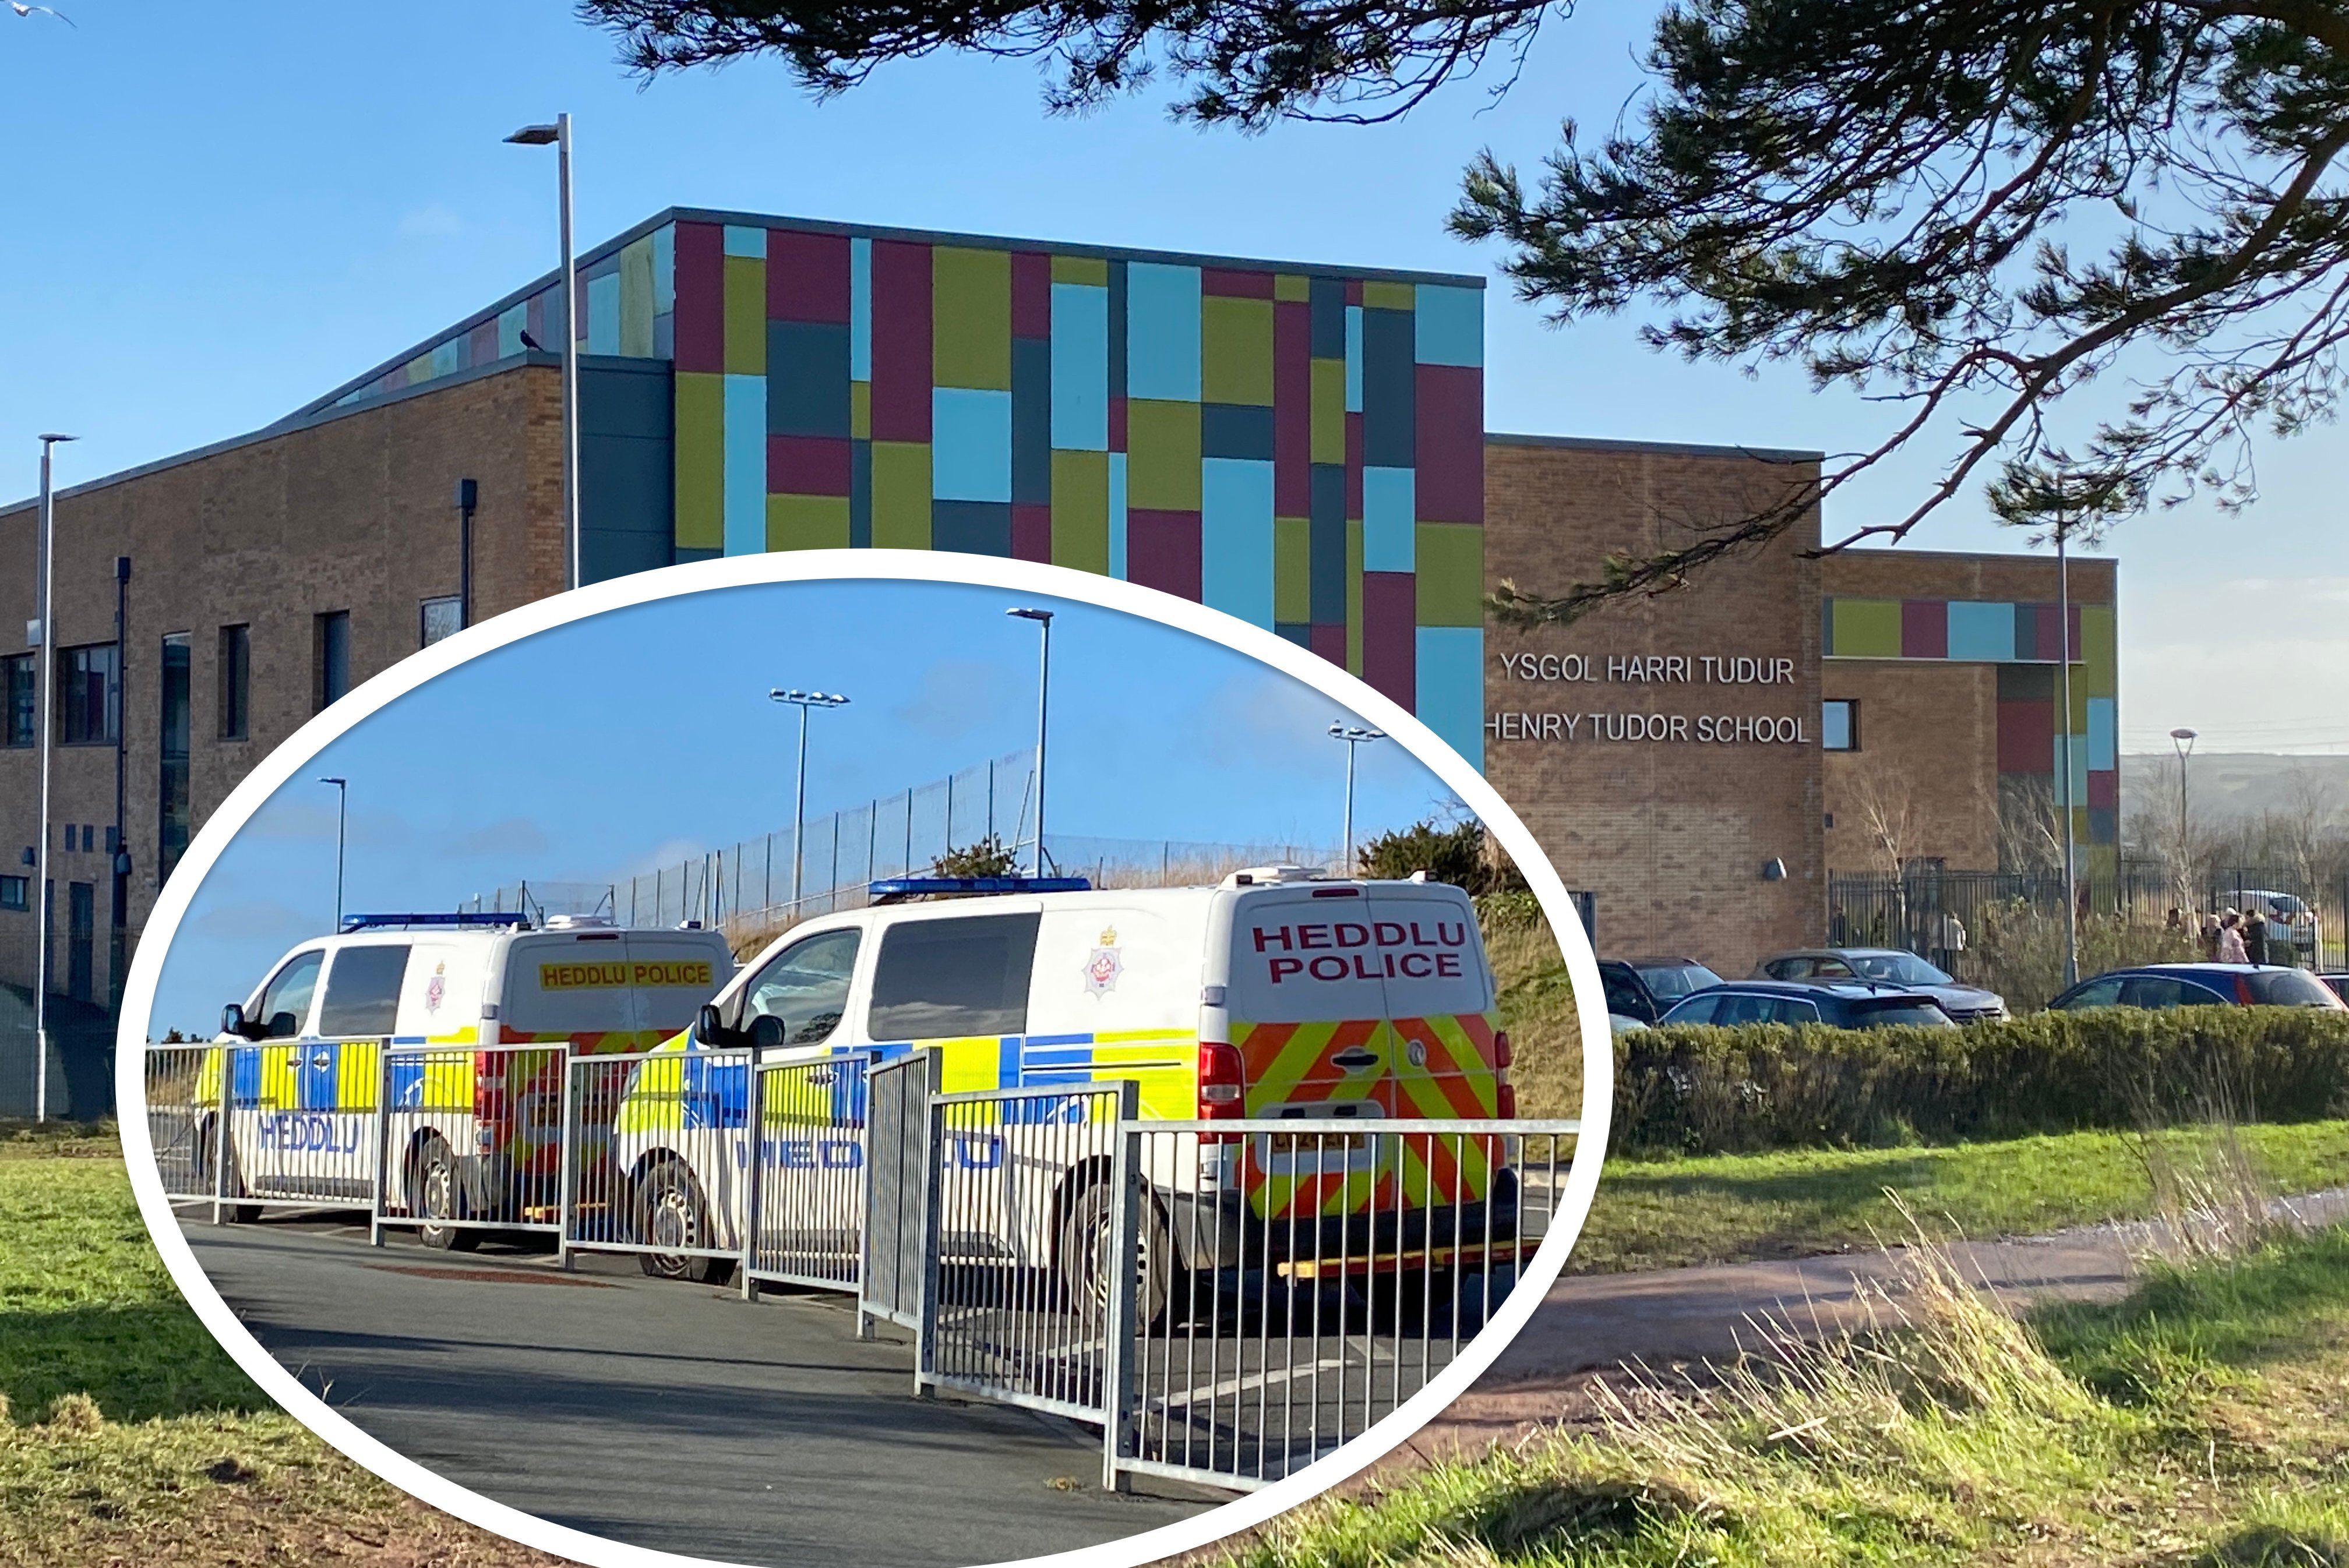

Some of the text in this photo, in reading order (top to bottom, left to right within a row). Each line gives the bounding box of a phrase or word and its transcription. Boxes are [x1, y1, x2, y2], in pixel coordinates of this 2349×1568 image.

[1500, 653, 1794, 684] YSGOL HARRI TUDUR
[1484, 712, 1811, 743] HENRY TUDOR SCHOOL
[1253, 922, 1466, 952] HEDDLU
[542, 965, 710, 986] HEDDLU POLICE
[1269, 953, 1463, 984] POLICE
[258, 1115, 359, 1154] HEDDLU
[736, 1138, 1001, 1169] HEDU
